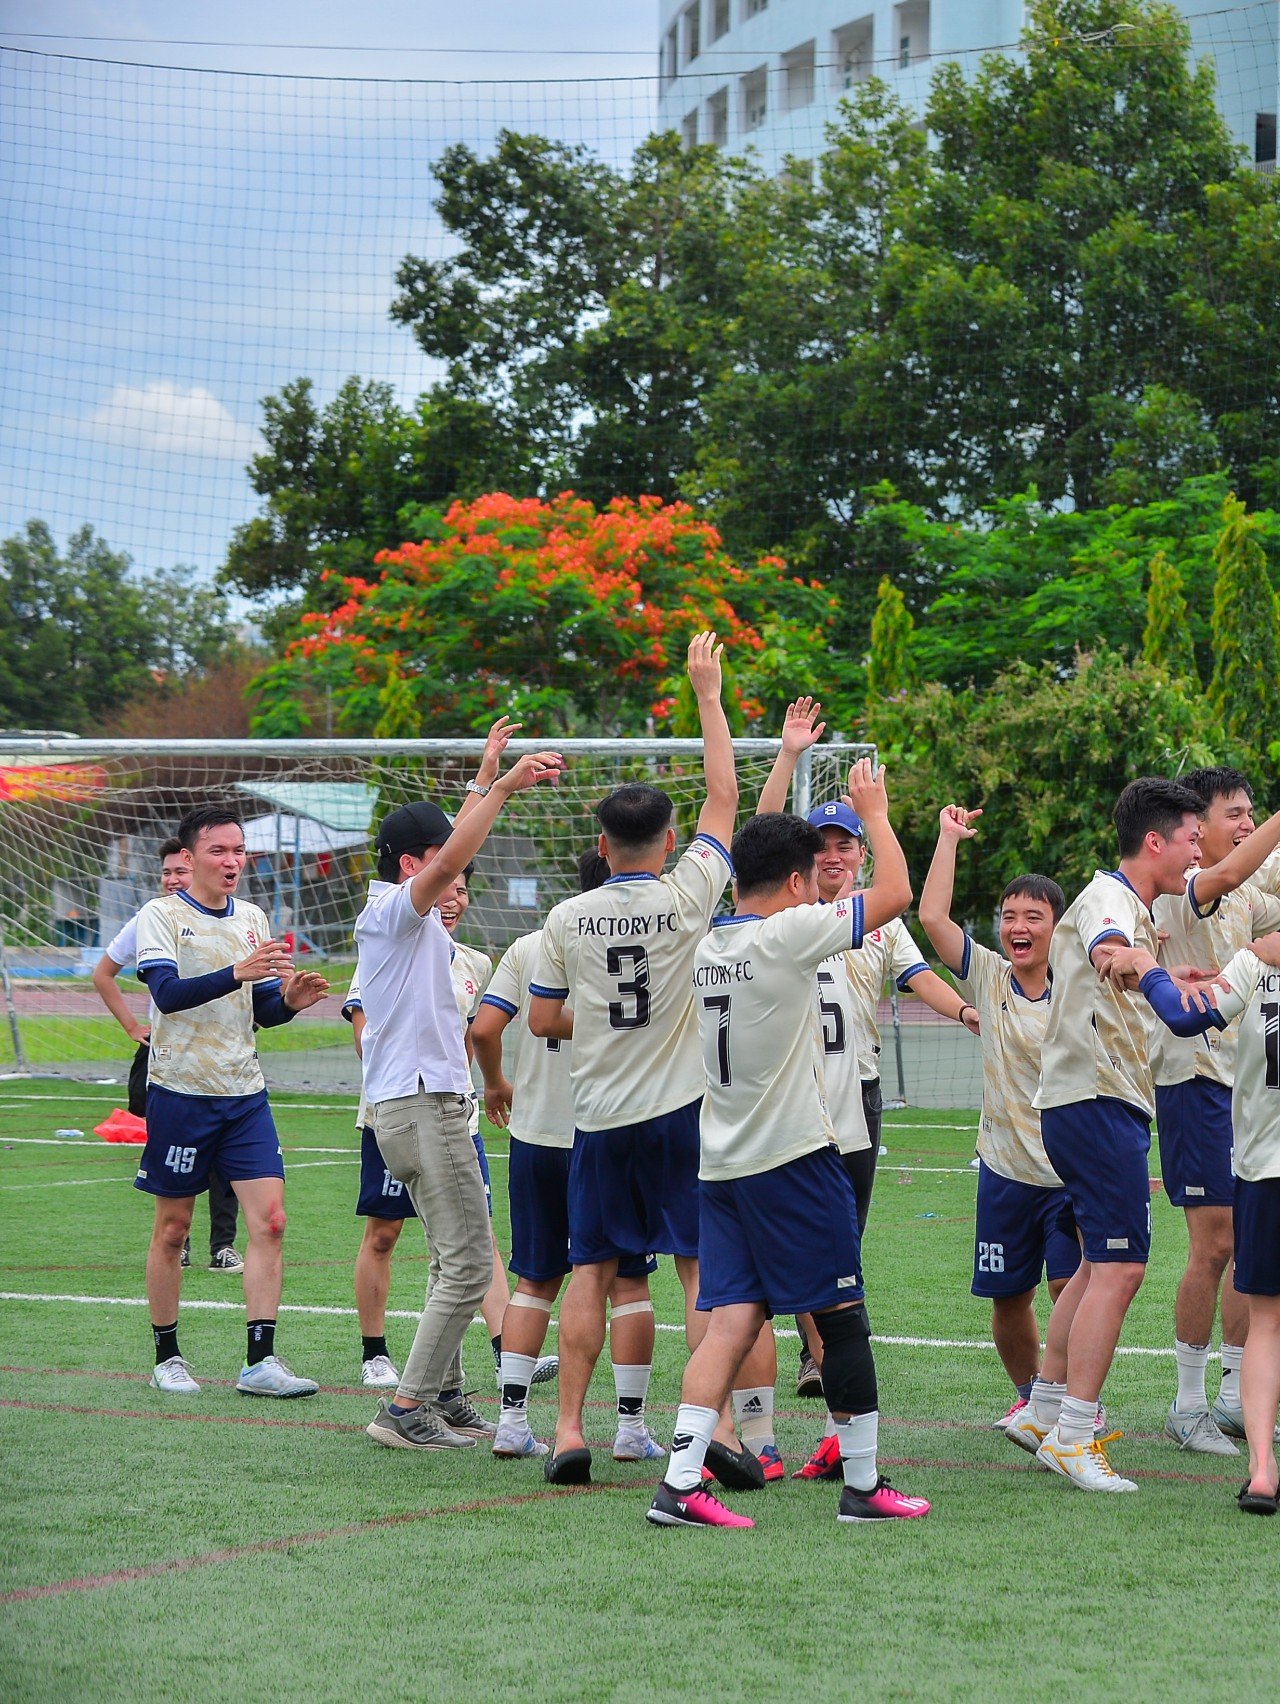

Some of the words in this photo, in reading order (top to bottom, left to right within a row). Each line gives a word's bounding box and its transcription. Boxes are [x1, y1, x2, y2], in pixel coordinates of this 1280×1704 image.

[578, 915, 652, 937] FACTORY
[657, 912, 678, 933] FC
[606, 945, 652, 1031] 3
[692, 963, 733, 988] ACTORY
[735, 960, 754, 982] FC
[703, 994, 732, 1087] 7
[165, 1145, 198, 1174] 49
[979, 1241, 1005, 1273] 26
